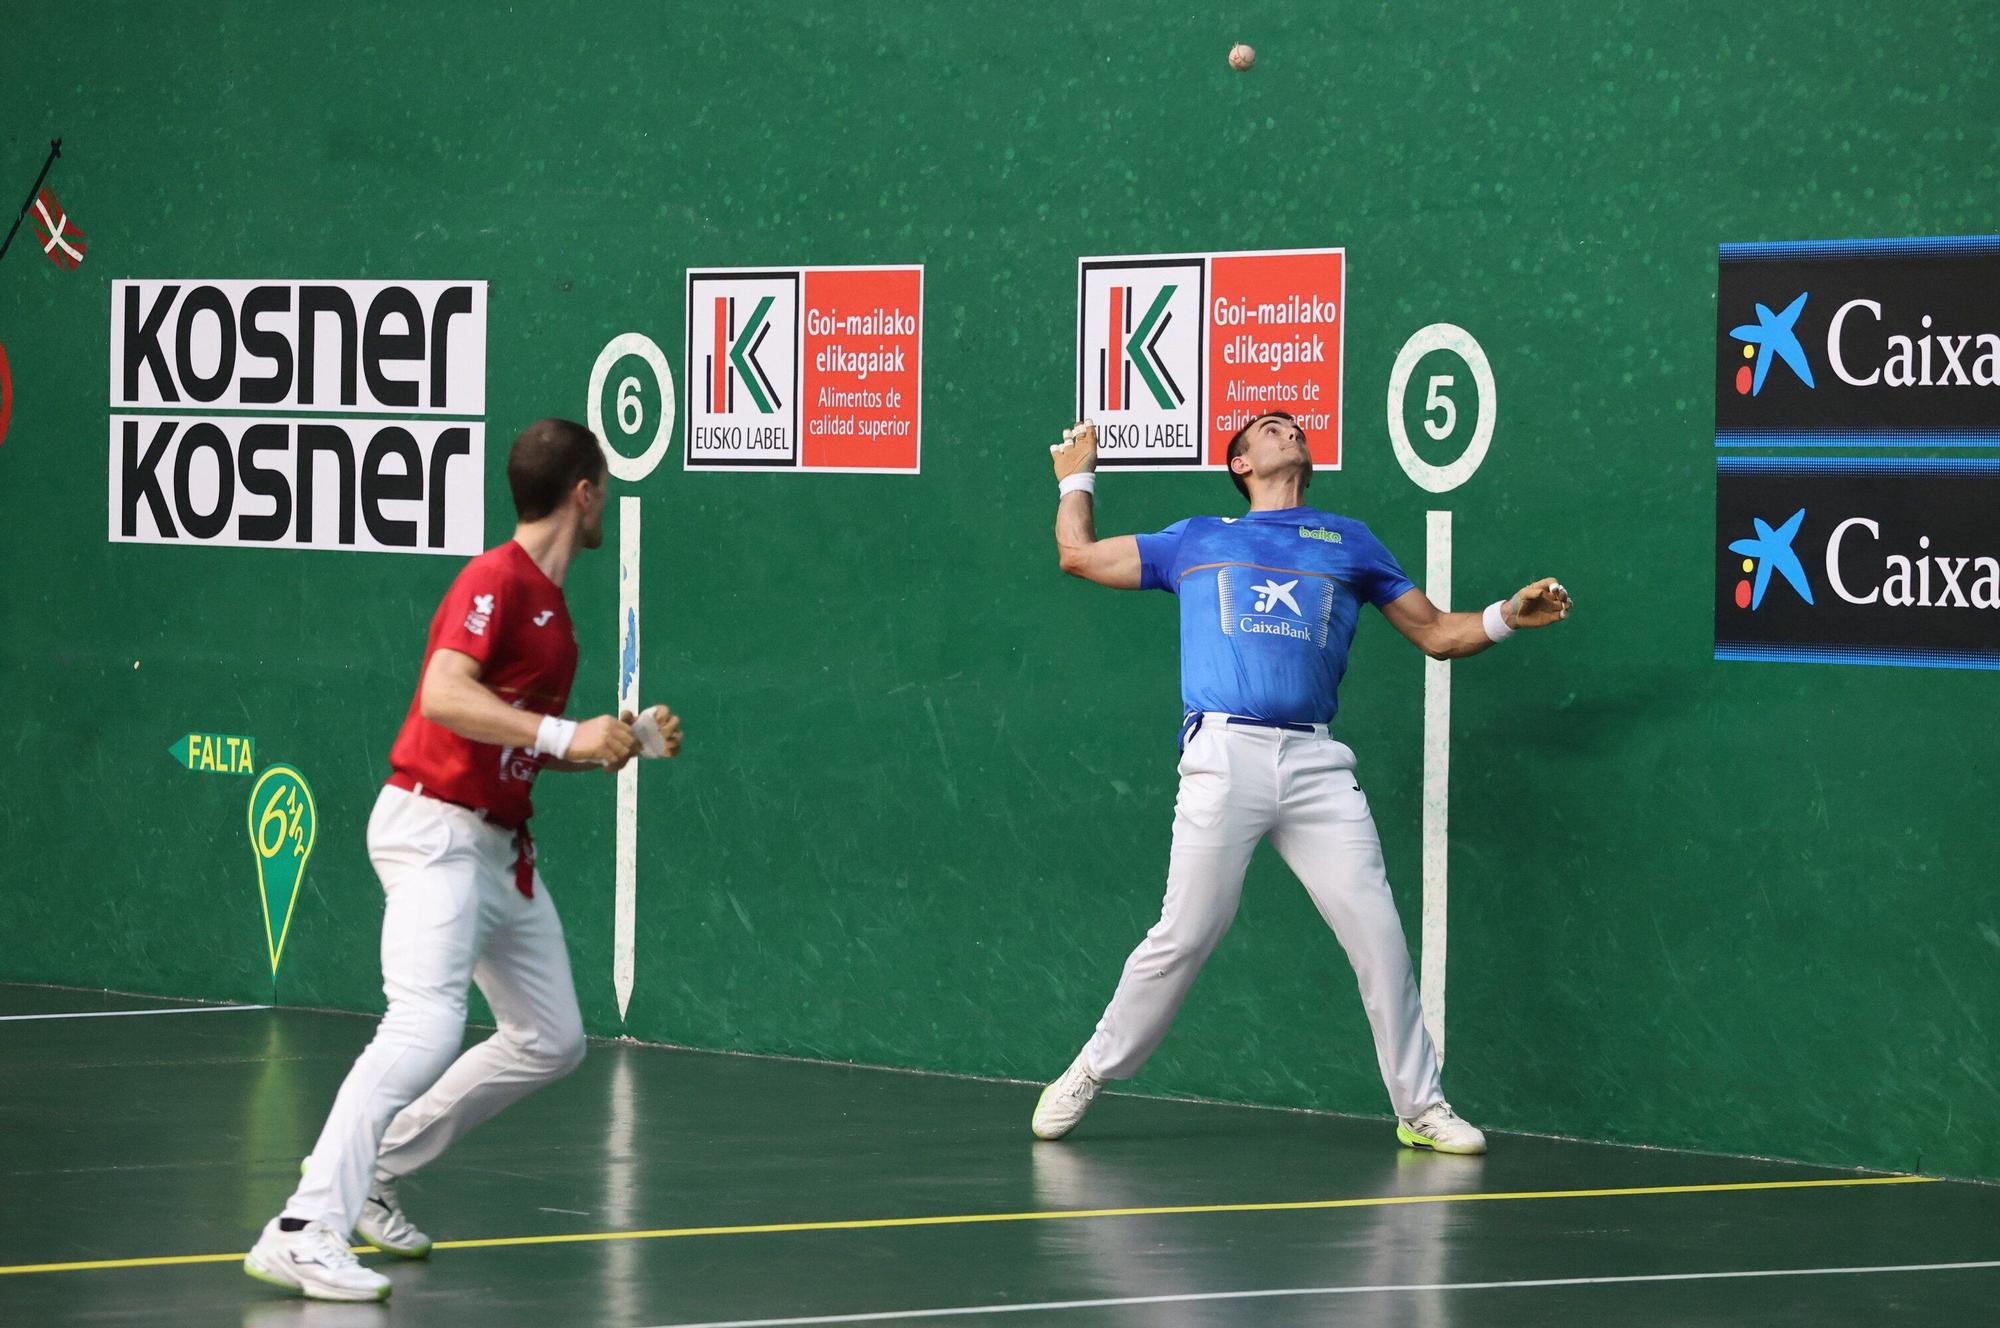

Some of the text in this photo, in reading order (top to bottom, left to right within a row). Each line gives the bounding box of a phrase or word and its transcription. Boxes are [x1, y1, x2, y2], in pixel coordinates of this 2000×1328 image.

[807, 308, 915, 335] Goi-mailako
[1213, 294, 1336, 326] Goi-mailako
[1223, 334, 1325, 371] elikagaiak
[1826, 298, 2000, 387] Caixa
[816, 345, 904, 379] elikagaiak
[617, 376, 643, 435] 6
[818, 387, 901, 408] Alimentos de
[1226, 378, 1320, 402] Alimentos de
[1423, 375, 1457, 440] 5
[696, 427, 789, 450] EUSKO LABEL
[809, 415, 910, 441] calidad superior
[1093, 424, 1193, 449] USKO LABEL
[1825, 516, 2000, 610] Caixa
[1239, 617, 1311, 642] CaixaBank
[188, 735, 254, 774] FALTA
